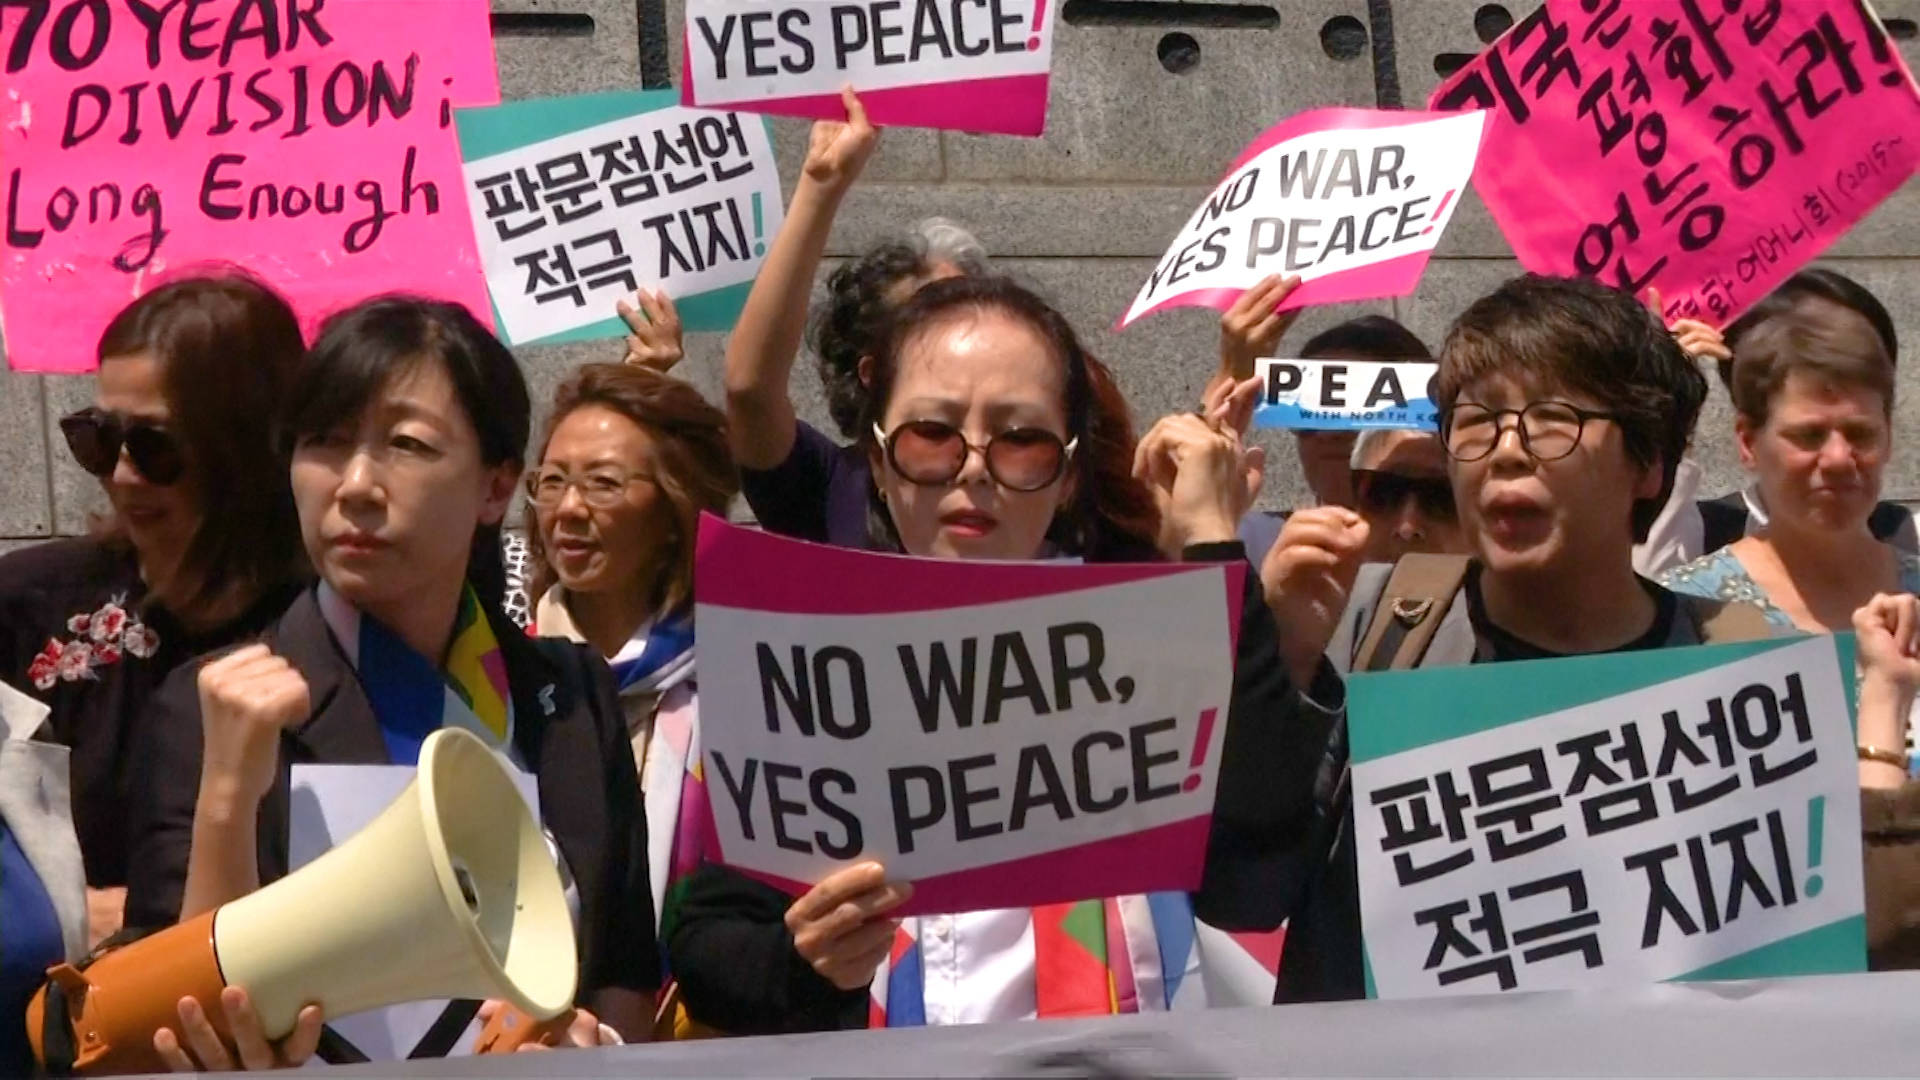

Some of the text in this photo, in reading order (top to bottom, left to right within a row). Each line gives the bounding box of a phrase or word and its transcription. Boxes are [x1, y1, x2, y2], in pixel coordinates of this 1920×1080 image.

[124, 0, 334, 69] YEAR
[696, 0, 1048, 79] YES PEACE!
[61, 52, 420, 149] DIVISION
[6, 146, 440, 272] Long Enough
[475, 112, 754, 242] 판문점선언
[1195, 144, 1416, 232] NO WAR,
[514, 191, 767, 307] 적극 지지!
[1146, 188, 1456, 300] YES PEACE!
[1350, 411, 1407, 422] NORTH
[756, 621, 1135, 740] NO WAR,
[710, 707, 1219, 861] YES PEACE!
[1370, 672, 1818, 888] 판문점선언
[1414, 795, 1826, 991] 적극 지지!
